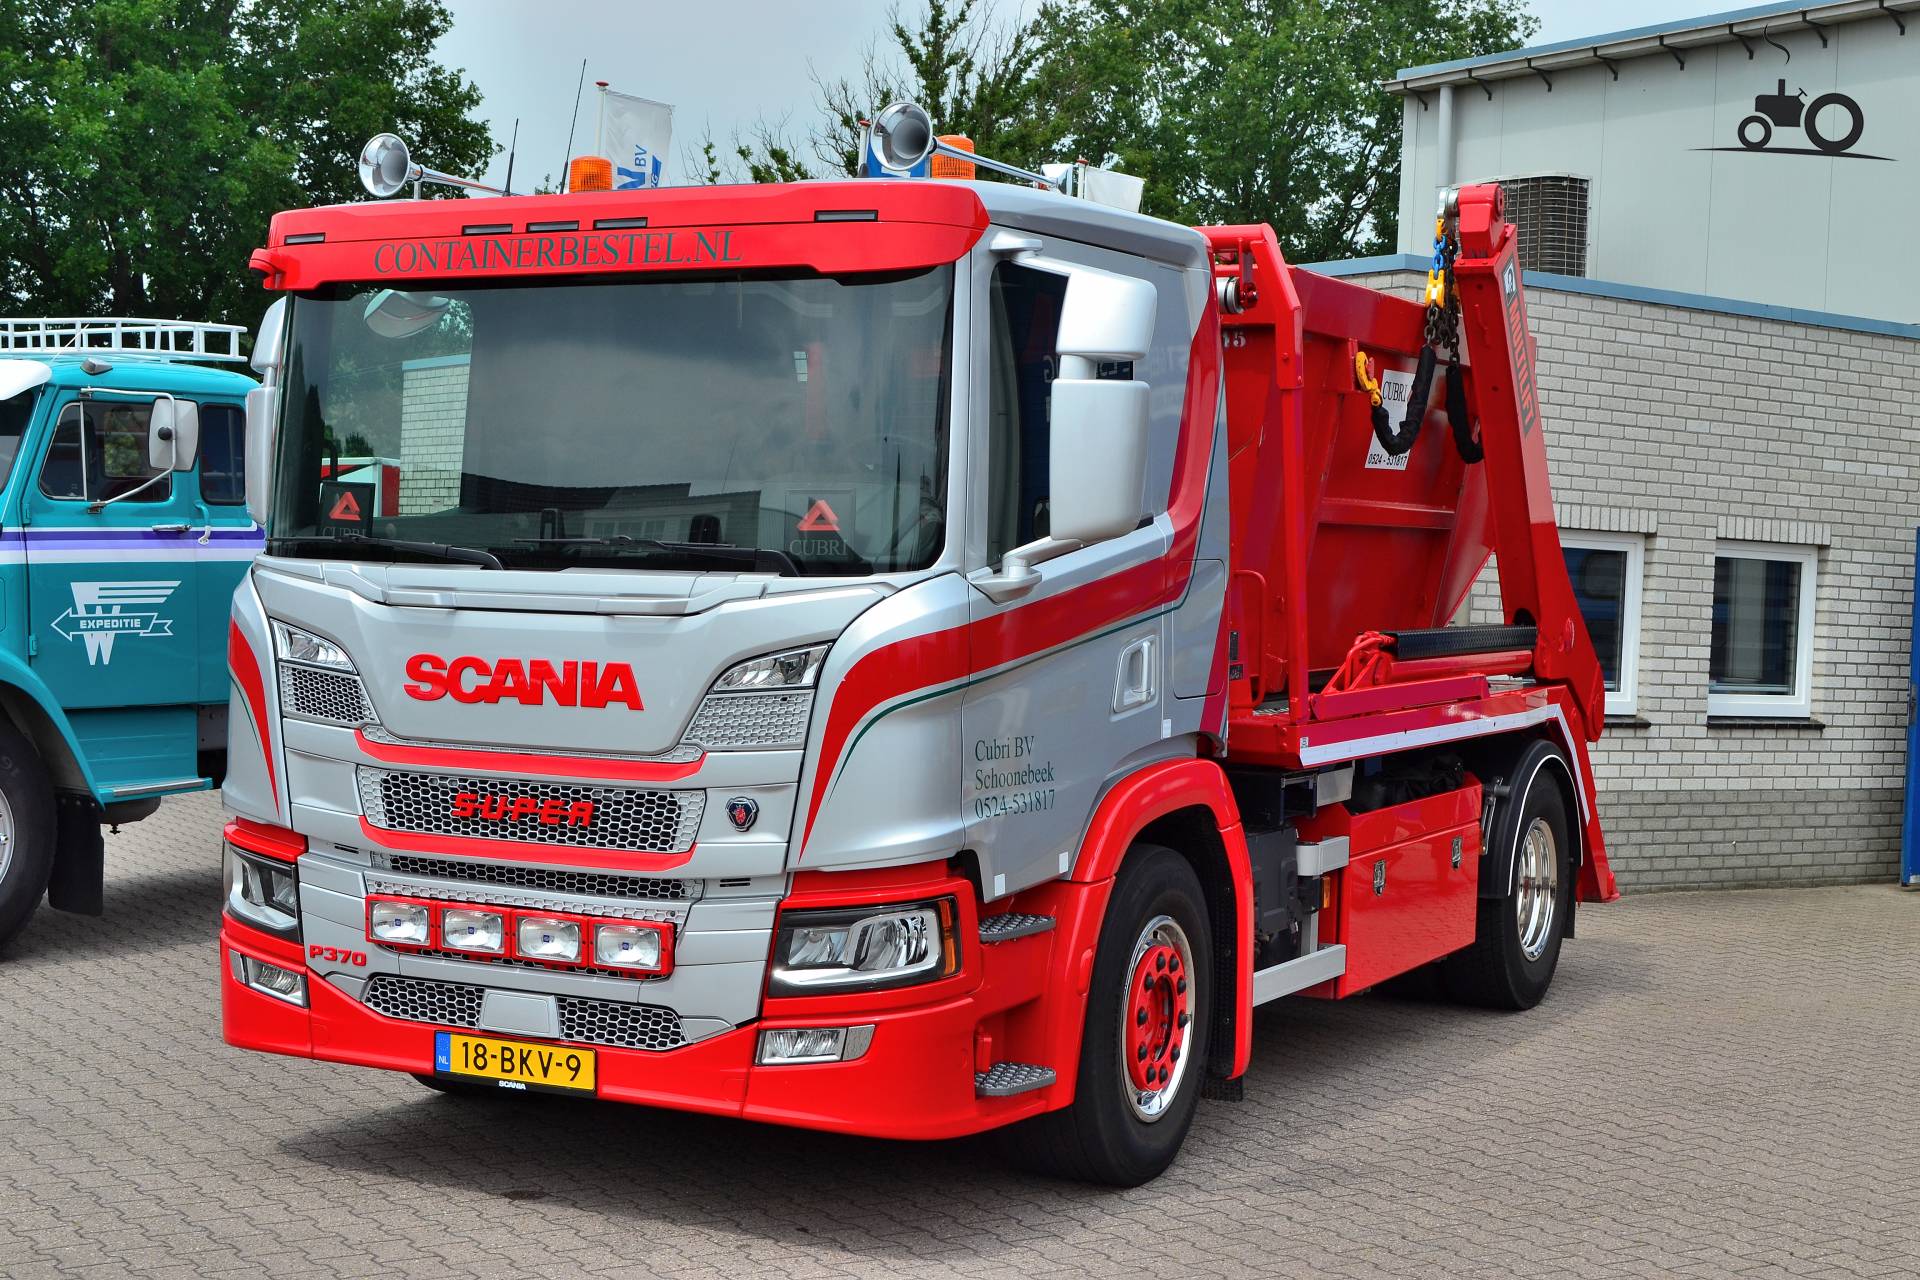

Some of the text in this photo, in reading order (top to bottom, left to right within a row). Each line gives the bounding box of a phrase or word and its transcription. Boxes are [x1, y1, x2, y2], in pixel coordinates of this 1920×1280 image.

[634, 144, 647, 167] BV
[374, 230, 742, 274] CONTAINERBESTEL.NL
[1509, 298, 1534, 424] MULTILIFT
[1382, 380, 1408, 402] CUBRI
[1367, 453, 1383, 466] 0524
[789, 539, 849, 556] CUBRI
[79, 618, 142, 630] EXPEDITIE
[403, 653, 645, 711] SCANIA
[975, 735, 1035, 762] Cubri BV
[975, 761, 1055, 791] Schoonebeek
[451, 792, 597, 828] SUPER
[975, 789, 1056, 819] 0524-531817
[309, 943, 368, 967] P370
[438, 1041, 581, 1081] NL 18-BKV-9
[498, 1080, 527, 1090] SCANIA
